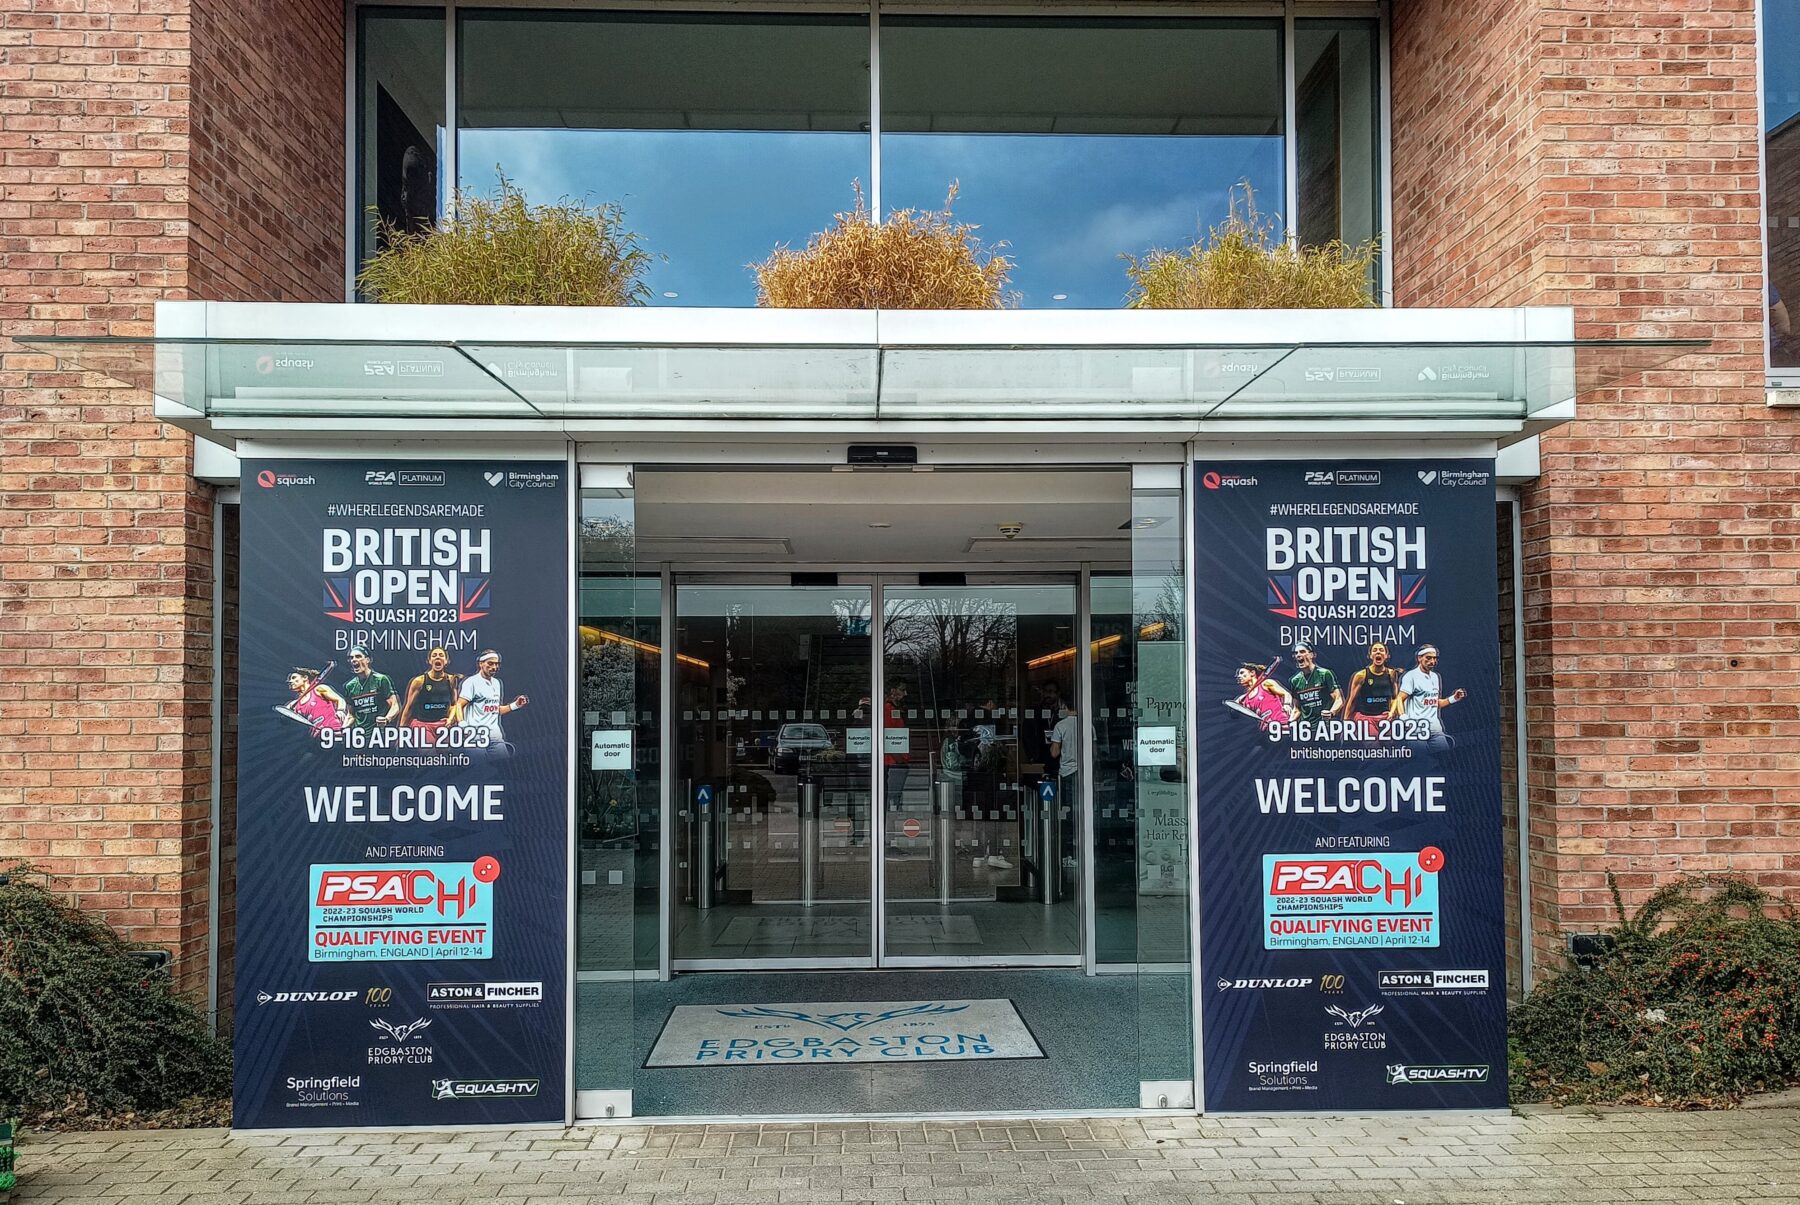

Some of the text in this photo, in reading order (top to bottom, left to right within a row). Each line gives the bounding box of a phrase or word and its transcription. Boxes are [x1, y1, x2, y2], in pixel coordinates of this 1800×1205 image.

[277, 475, 316, 487] squash
[365, 472, 442, 482] PSA PLATINUM
[509, 472, 558, 482] Birmingham
[1221, 476, 1258, 488] squash
[1305, 472, 1377, 482] PSA PLATINUM
[1442, 471, 1489, 480] Birmingham
[509, 479, 556, 489] City Council
[1442, 478, 1486, 487] City Council
[328, 504, 485, 517] #WHERELEGENDSAREMADE
[1270, 503, 1419, 516] #WHERELEGENDSAREMADE
[322, 528, 491, 572] BRITISH
[1266, 526, 1426, 571] BRITISH
[354, 569, 458, 605] OPEN
[1298, 567, 1395, 601] OPEN
[355, 609, 458, 625] SQUASH 2023
[1298, 605, 1396, 621] SQUASH 2023
[335, 630, 477, 650] BIRMINGHAM
[1280, 625, 1415, 646] BIRMINGHAM
[1269, 720, 1430, 742] 9-16 APRIL 2023
[320, 727, 489, 749] 9-16 APRIL 2023
[1290, 747, 1412, 761] britishopensquash.info
[343, 754, 470, 769] britishopensquash.info
[1254, 777, 1446, 814] WELCOME
[304, 785, 504, 823] WELCOME
[1147, 829, 1170, 841] Hair
[1315, 836, 1390, 848] AND FEATURING
[366, 846, 443, 857] AND FEATURING
[1277, 865, 1354, 890] PSA
[323, 875, 405, 900] PSA
[1270, 919, 1433, 935] QUALIFYING EVENT
[315, 929, 486, 947] QUALIFYING EVENT
[1332, 936, 1378, 945] ENGLAND
[1385, 936, 1406, 947] April
[1408, 936, 1430, 944] 12-14
[380, 948, 429, 957] ENGLAND
[435, 947, 457, 959] April
[460, 947, 482, 956] 12-14
[1233, 978, 1312, 989] DUNLOP
[1320, 975, 1345, 990] 100
[1382, 974, 1485, 984] ASTON & FINCHER
[273, 991, 358, 1002] DUNLOP
[365, 987, 392, 1002] 100
[430, 986, 539, 998] ASTON & FINCHER
[700, 1034, 988, 1050] EDGBASTON
[1324, 1033, 1385, 1041] EDGBASTON
[368, 1047, 432, 1055] EDGBASTON
[1324, 1041, 1386, 1049] PRIORY CLUB
[695, 1044, 995, 1061] PRIORY CLUB
[368, 1055, 433, 1065] PRIORY CLUB
[1249, 1061, 1317, 1076] Springfield
[1408, 1067, 1486, 1079] SQUASHTV
[286, 1076, 360, 1090] Springfield
[1260, 1074, 1307, 1085] Solutions
[454, 1082, 536, 1094] SQUASHTV
[298, 1090, 348, 1102] Solutions
